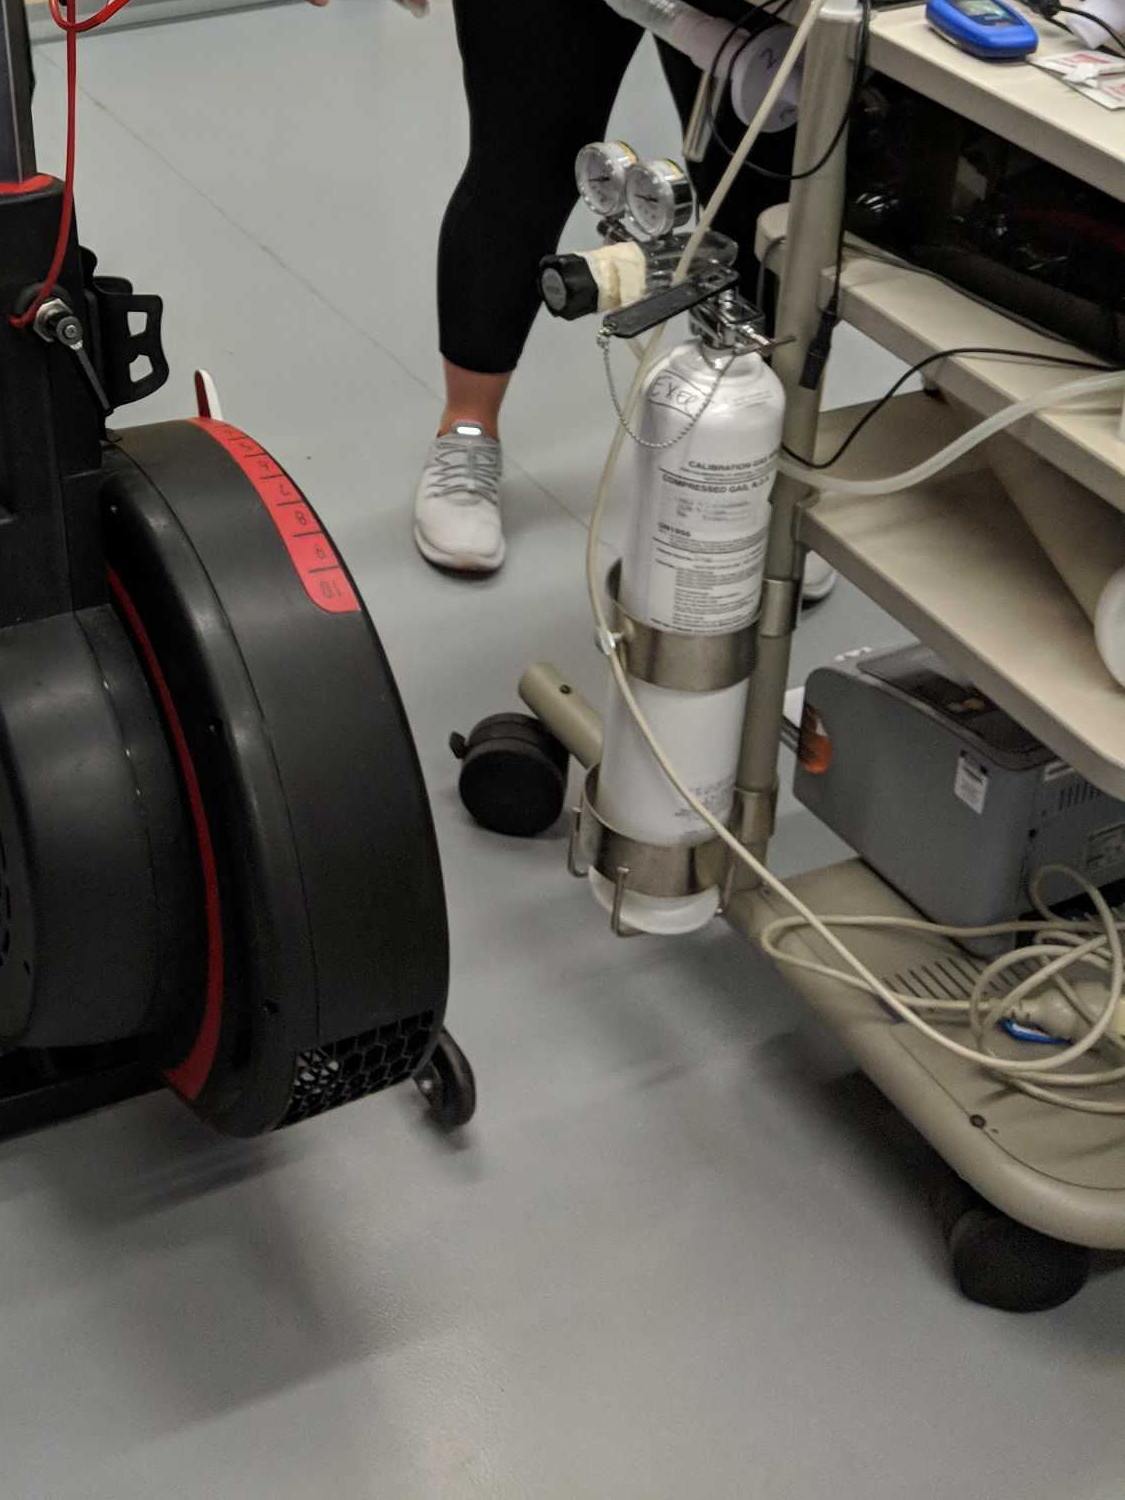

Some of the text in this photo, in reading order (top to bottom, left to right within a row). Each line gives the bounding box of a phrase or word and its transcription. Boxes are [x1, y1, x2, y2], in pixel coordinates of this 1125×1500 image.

[688, 459, 752, 472] CALIBRATION
[661, 473, 727, 494] COMPRESSED
[295, 510, 308, 526] 8
[319, 578, 342, 600] 10
